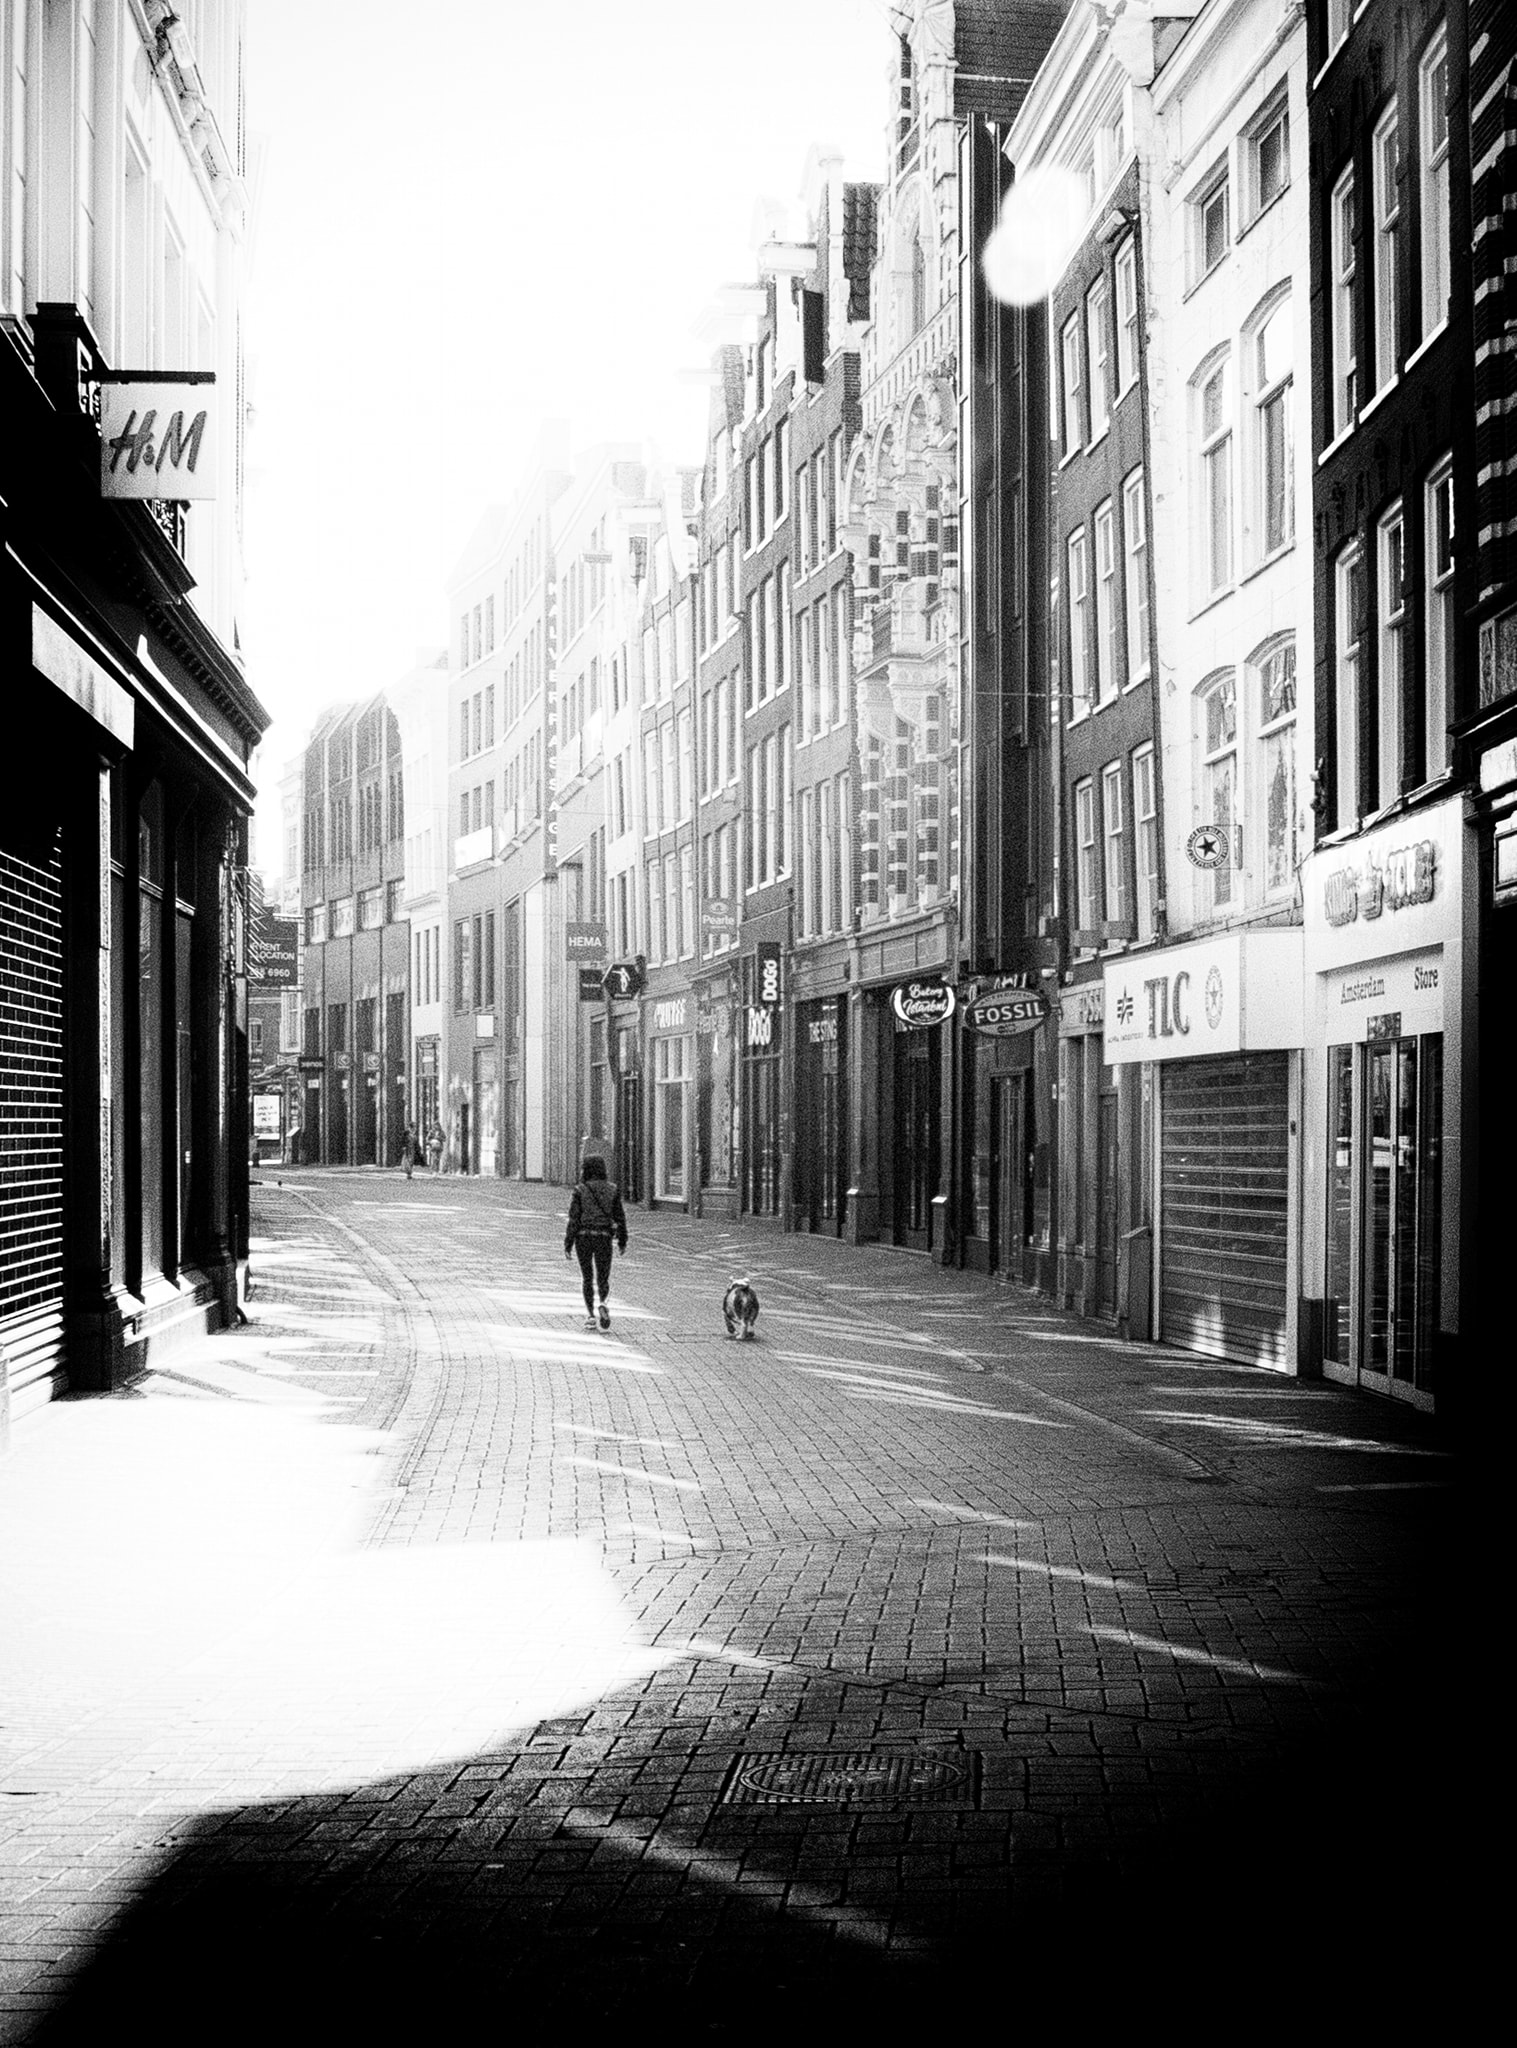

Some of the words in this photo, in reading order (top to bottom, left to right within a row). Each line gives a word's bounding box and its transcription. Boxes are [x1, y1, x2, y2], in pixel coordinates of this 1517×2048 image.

[109, 410, 207, 473] H&M
[702, 914, 735, 926] Pearle
[568, 936, 602, 947] HEMA
[1340, 975, 1385, 1005] Amsterdam
[1414, 965, 1439, 990] Store
[902, 999, 947, 1016] Istanbul
[974, 1001, 1045, 1024] FOSSIL
[1143, 970, 1190, 1040] TLC
